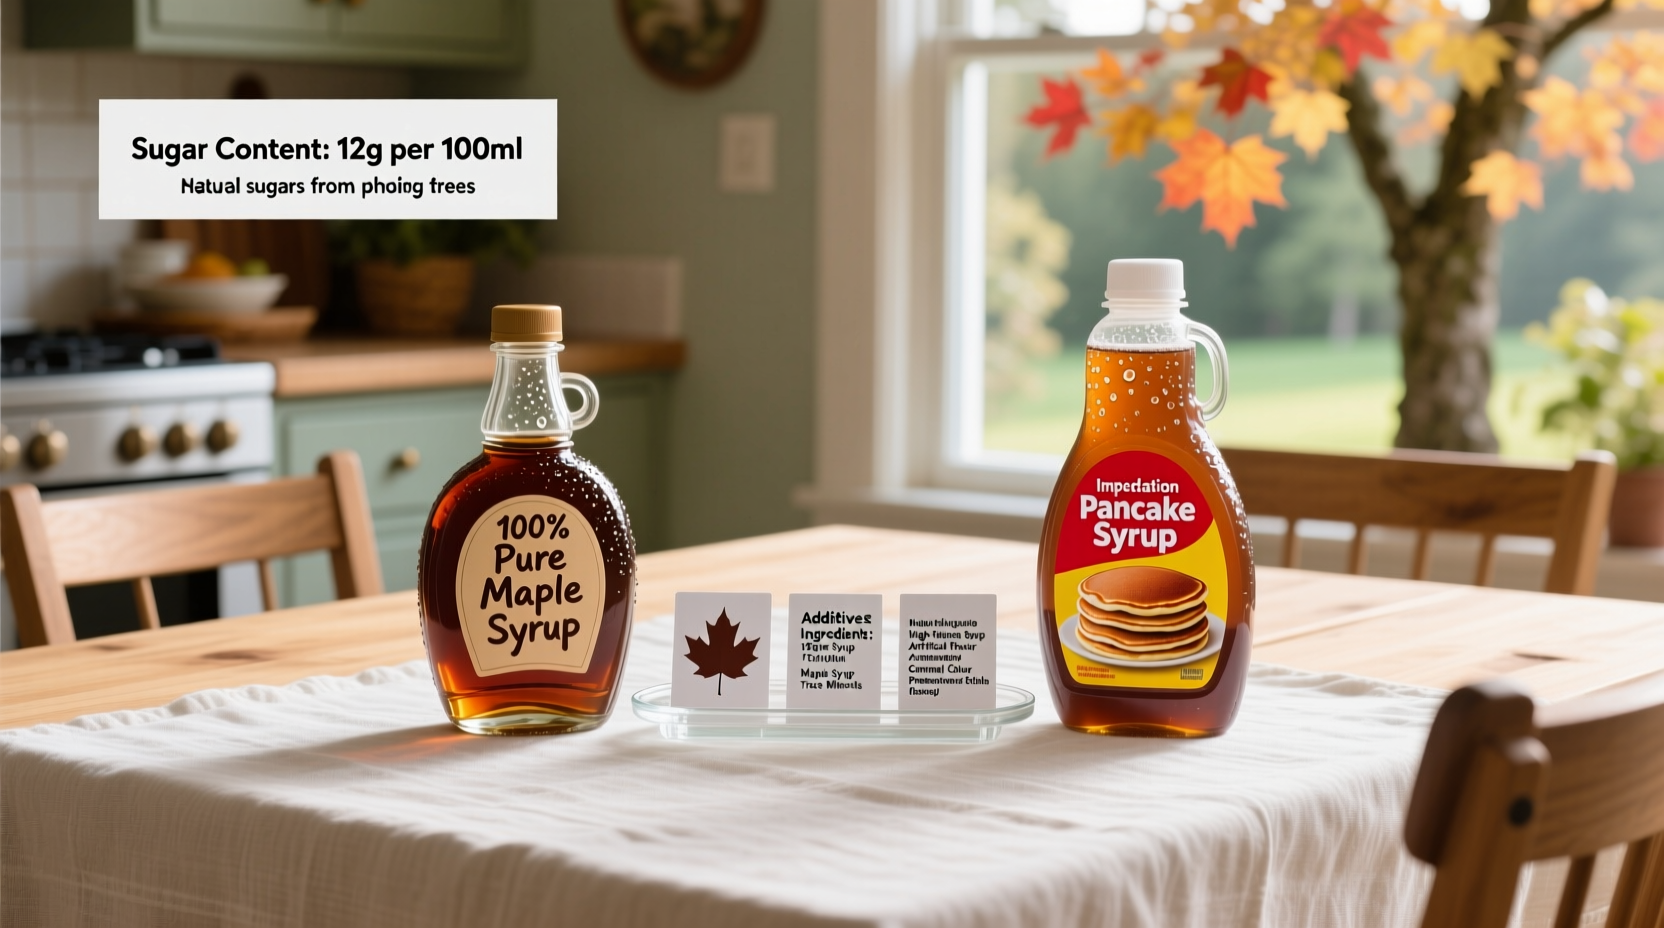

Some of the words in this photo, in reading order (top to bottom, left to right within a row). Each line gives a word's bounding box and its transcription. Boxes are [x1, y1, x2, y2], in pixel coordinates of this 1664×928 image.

[1080, 494, 1196, 522] Pancake
[496, 513, 570, 541] 100%
[1093, 521, 1178, 554] Syrup
[494, 543, 567, 574] Pure
[480, 573, 583, 616] Maple
[487, 613, 580, 657] Syrup
